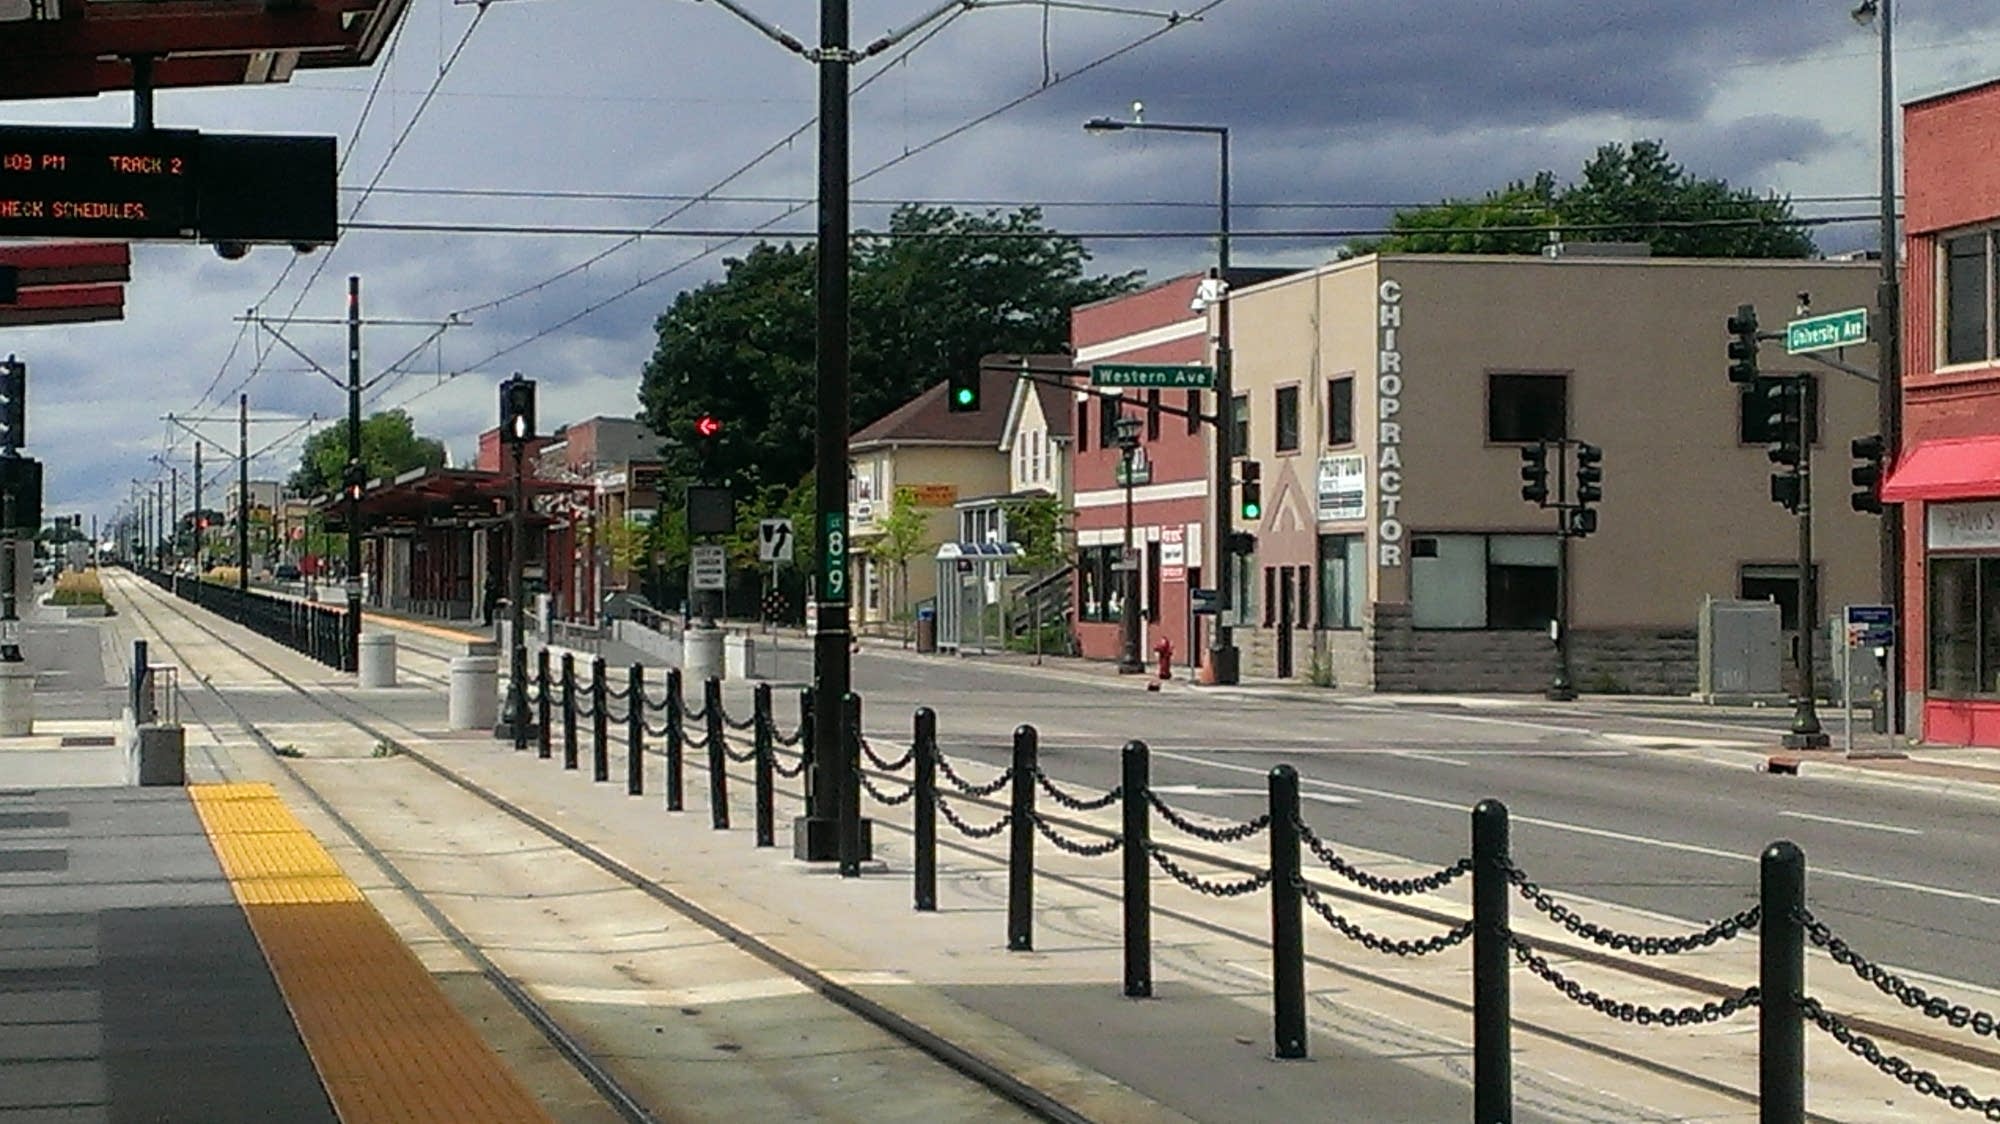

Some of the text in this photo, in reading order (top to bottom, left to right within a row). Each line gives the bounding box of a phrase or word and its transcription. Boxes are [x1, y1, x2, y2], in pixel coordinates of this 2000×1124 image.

[42, 154, 66, 171] PM
[109, 155, 162, 174] TRACK
[170, 157, 183, 175] 2
[0, 200, 44, 217] HECK
[1793, 321, 1861, 346] University Ave
[1100, 368, 1206, 384] Western Ave
[1380, 280, 1402, 566] CHIROPRACTOR
